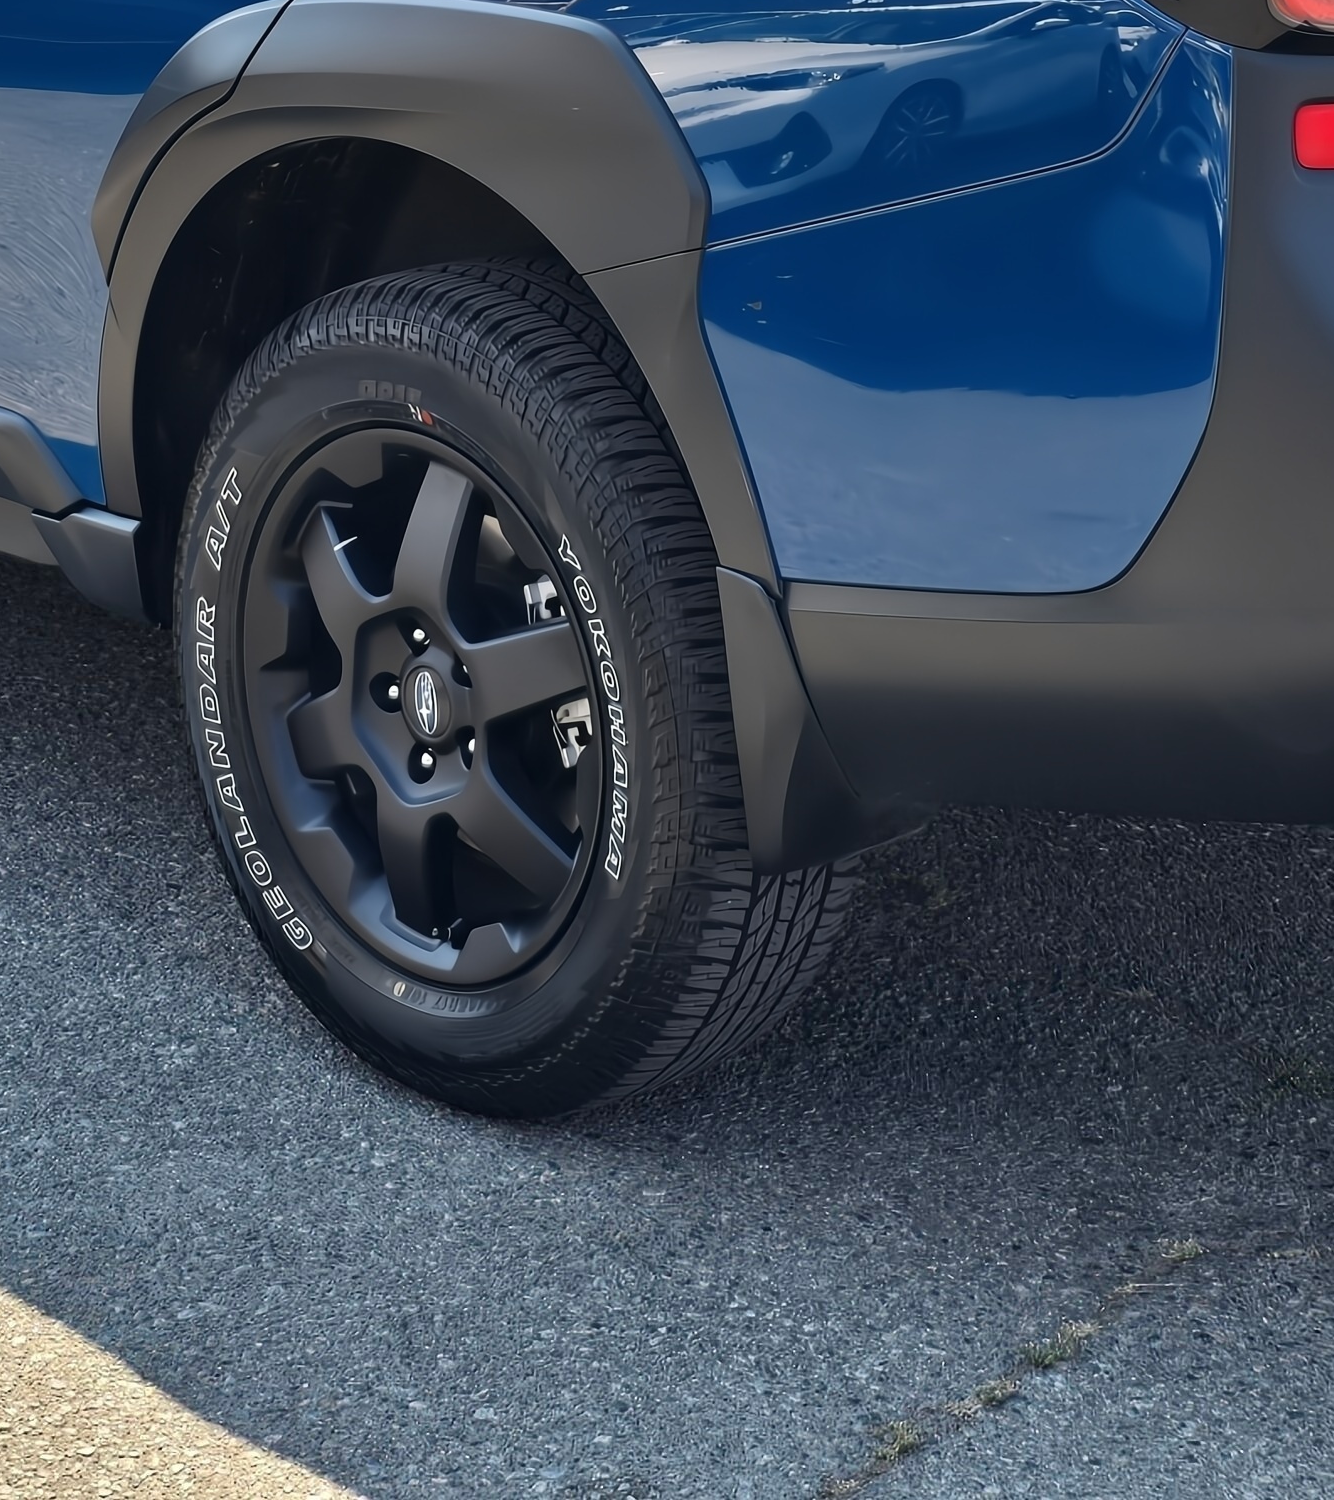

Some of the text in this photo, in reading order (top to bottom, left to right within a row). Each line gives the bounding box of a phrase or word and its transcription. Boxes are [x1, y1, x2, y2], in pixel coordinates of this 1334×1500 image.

[192, 466, 313, 951] GEOLANDAR A/T
[557, 534, 637, 882] YOKOHAMA
